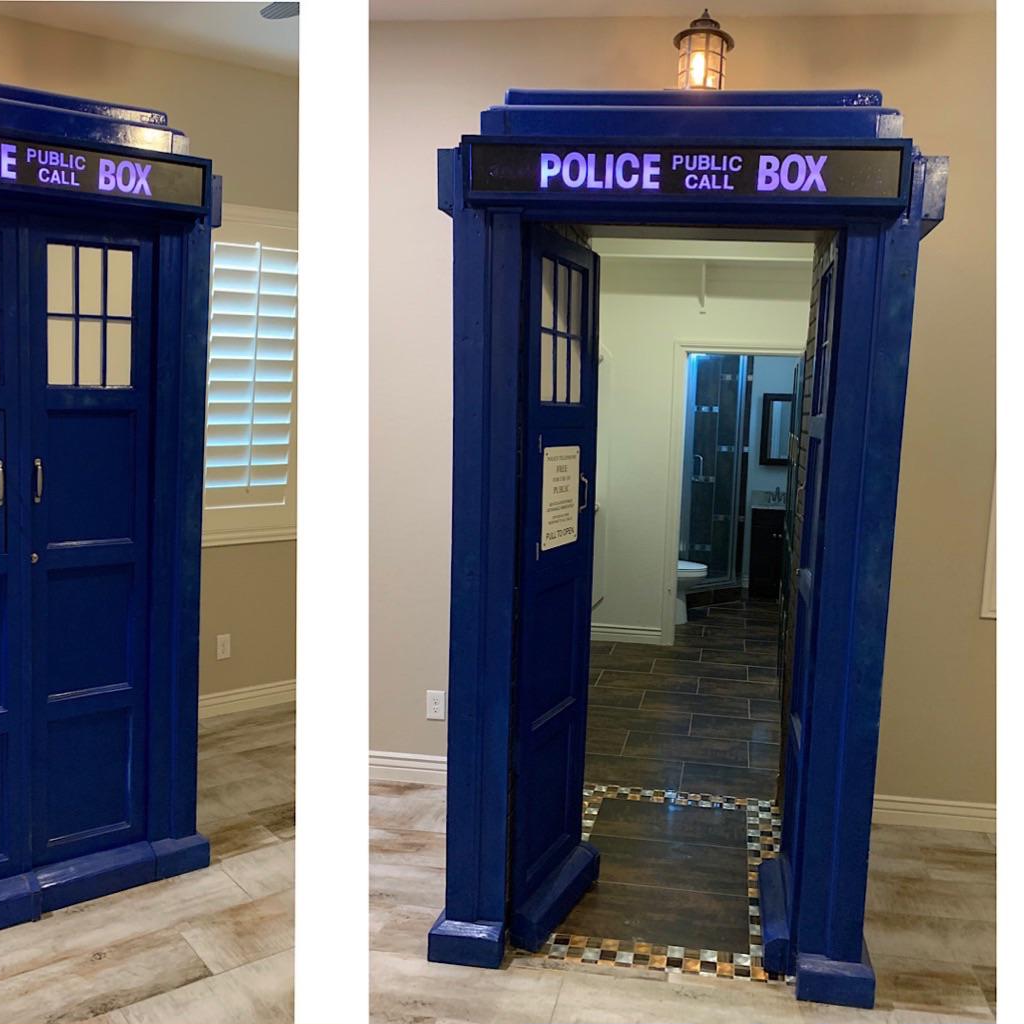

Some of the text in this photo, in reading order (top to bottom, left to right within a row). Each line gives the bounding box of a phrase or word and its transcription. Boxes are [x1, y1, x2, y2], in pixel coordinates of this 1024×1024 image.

[27, 148, 86, 170] PUBLIC
[672, 155, 742, 172] PUBLIC
[39, 169, 80, 186] CALL
[98, 159, 152, 196] BOX
[540, 152, 660, 189] POLICE
[757, 154, 827, 192] BOX
[685, 175, 734, 190] CALL
